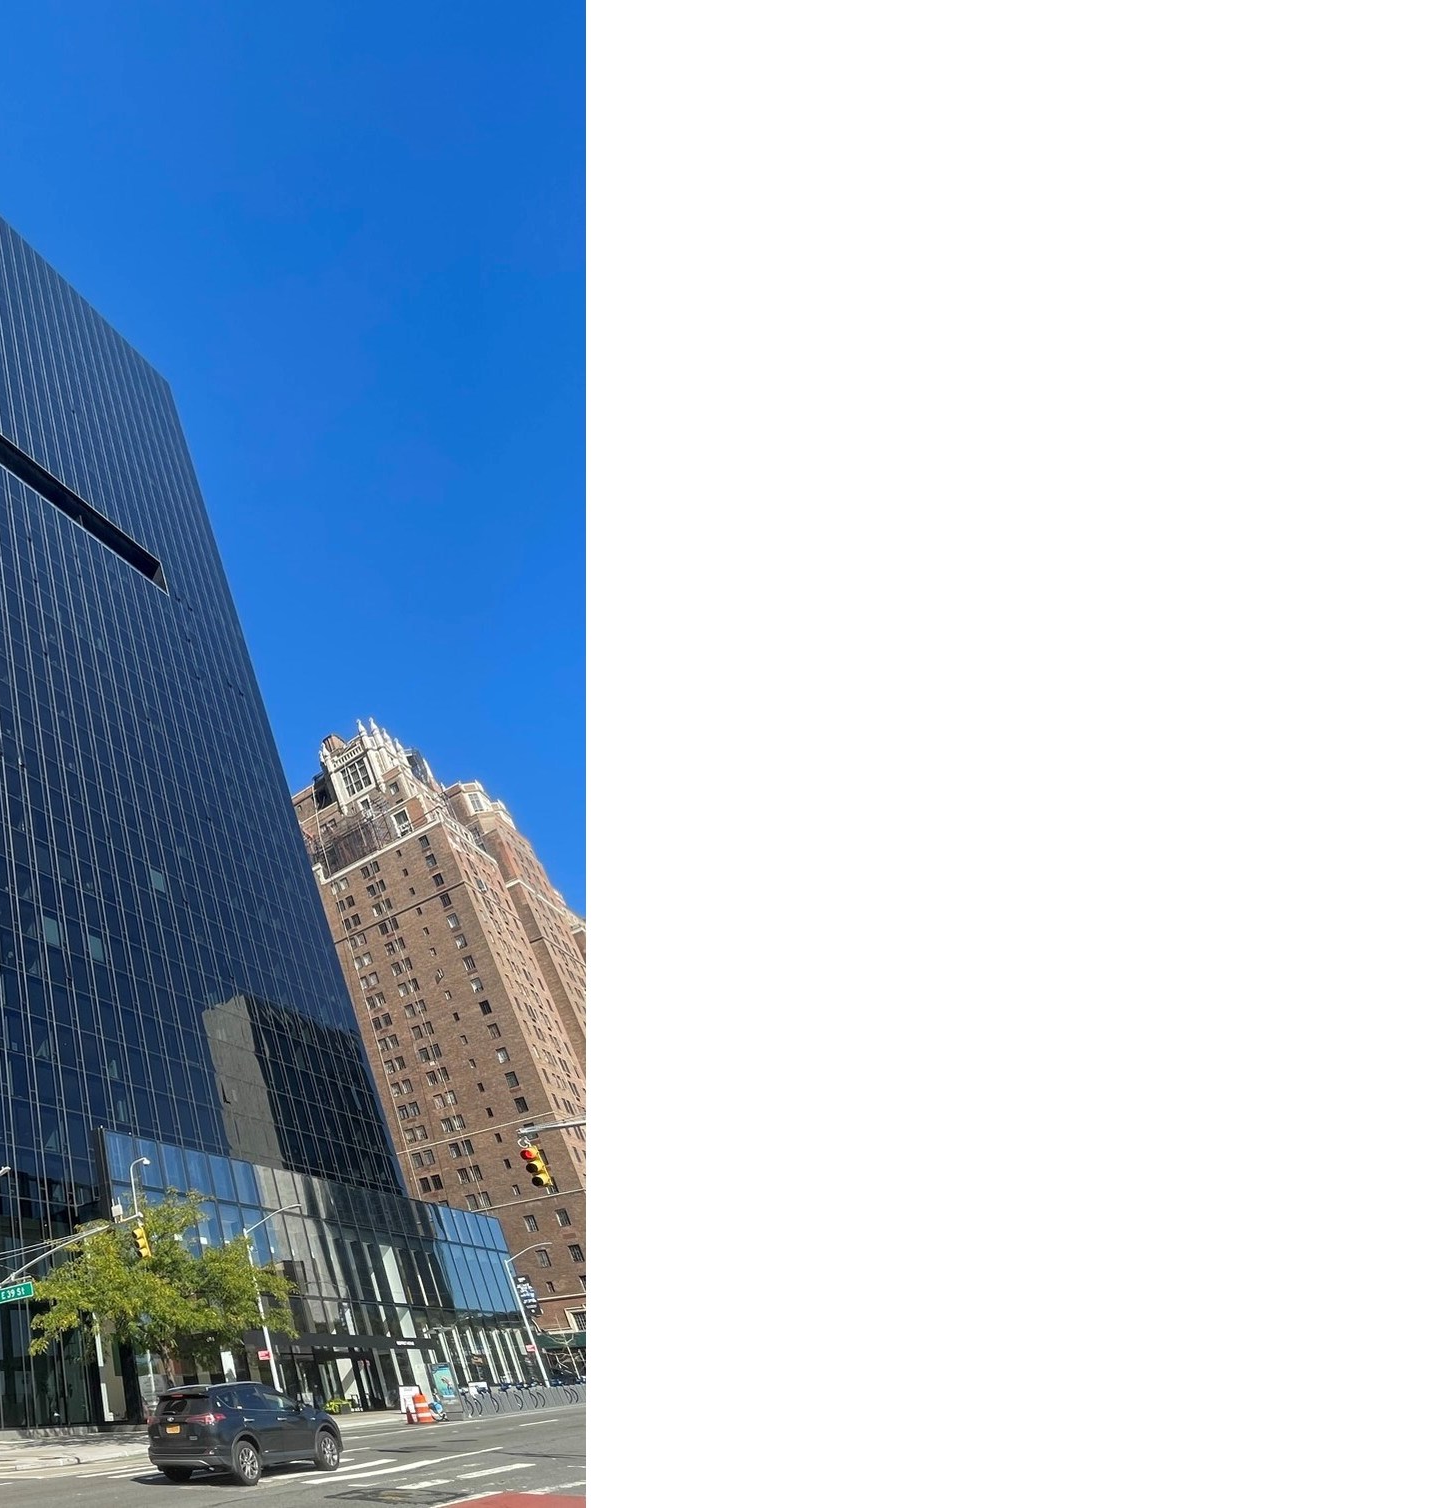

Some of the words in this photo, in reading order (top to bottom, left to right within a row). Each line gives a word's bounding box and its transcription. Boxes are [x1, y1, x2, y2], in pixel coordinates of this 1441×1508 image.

[1, 1291, 6, 1300] E
[7, 1290, 15, 1299] 39
[16, 1287, 25, 1296] St
